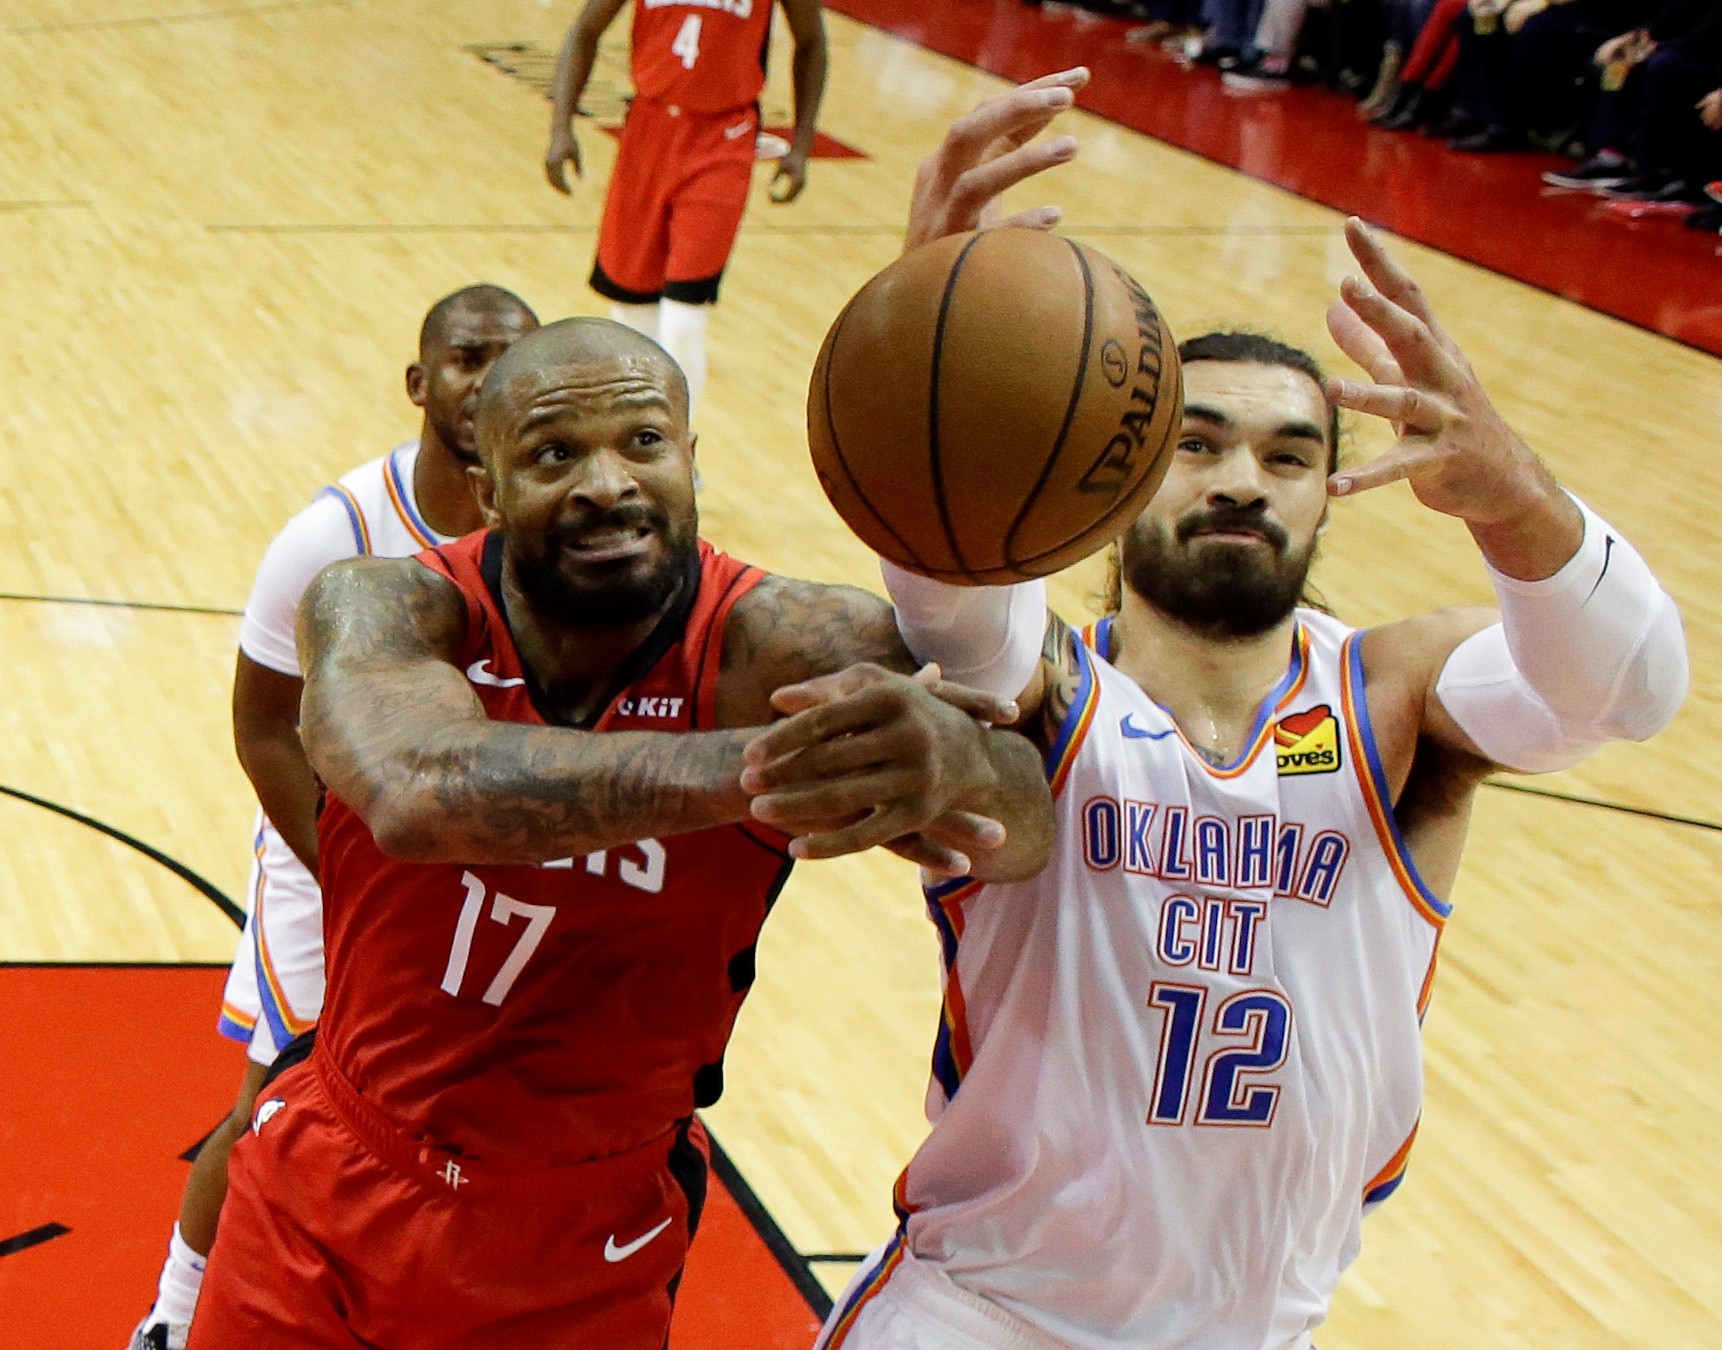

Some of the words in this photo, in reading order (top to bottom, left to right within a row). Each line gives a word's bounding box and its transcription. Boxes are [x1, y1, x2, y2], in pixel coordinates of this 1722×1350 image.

[671, 13, 703, 70] 4
[440, 870, 557, 1007] 17
[1157, 893, 1265, 976] CIT
[1146, 981, 1294, 1128] 12
